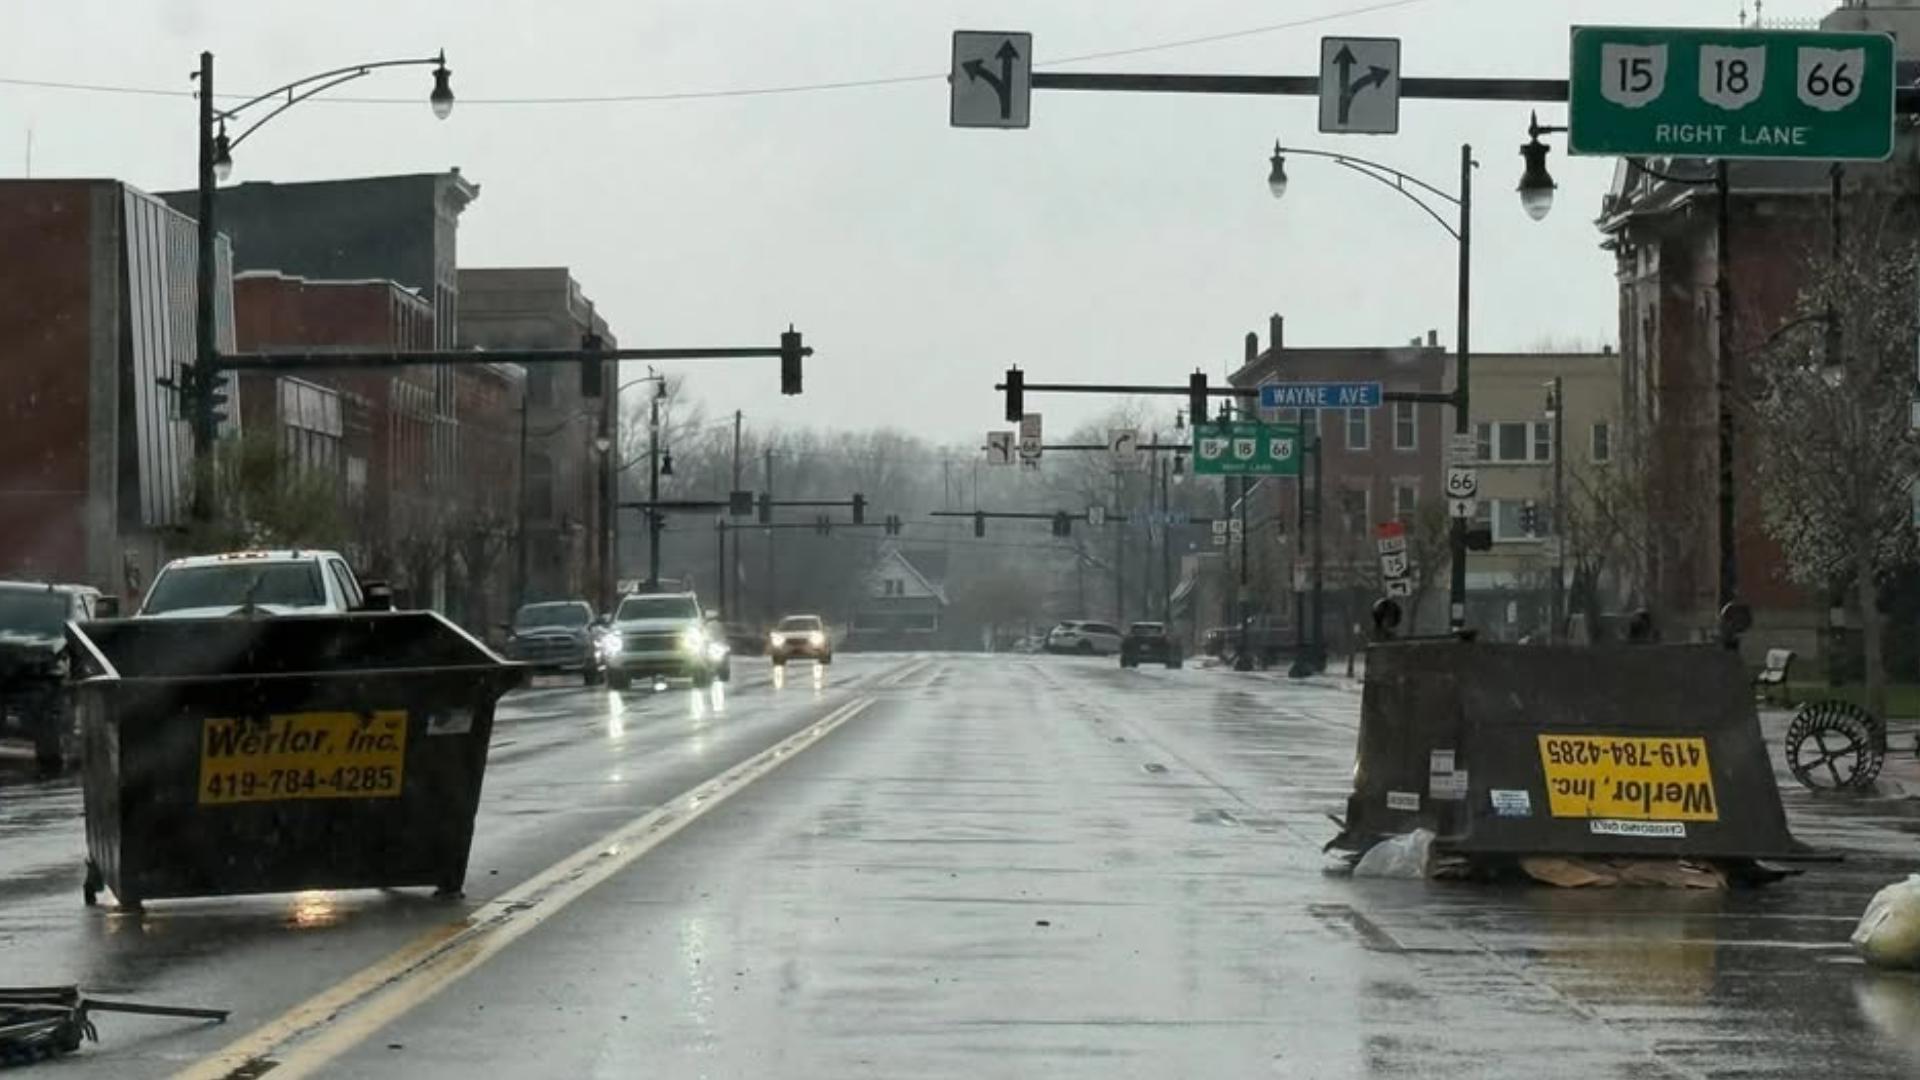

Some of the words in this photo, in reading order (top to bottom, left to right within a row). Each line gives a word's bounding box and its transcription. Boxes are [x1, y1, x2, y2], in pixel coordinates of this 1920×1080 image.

[1619, 58, 1653, 92] 15
[1715, 59, 1749, 94] 18
[1807, 63, 1855, 97] 66
[1655, 124, 1727, 143] RIGHT
[1740, 126, 1807, 145] LANE
[1272, 386, 1329, 404] WAYNE
[1339, 386, 1370, 404] AVE
[1273, 442, 1289, 456] 66
[1450, 474, 1473, 490] 66
[345, 729, 399, 753] Inc.
[1547, 740, 1700, 767] 419-784-4285
[207, 764, 393, 797] 419-784-4285
[1552, 778, 1595, 801] Inc.
